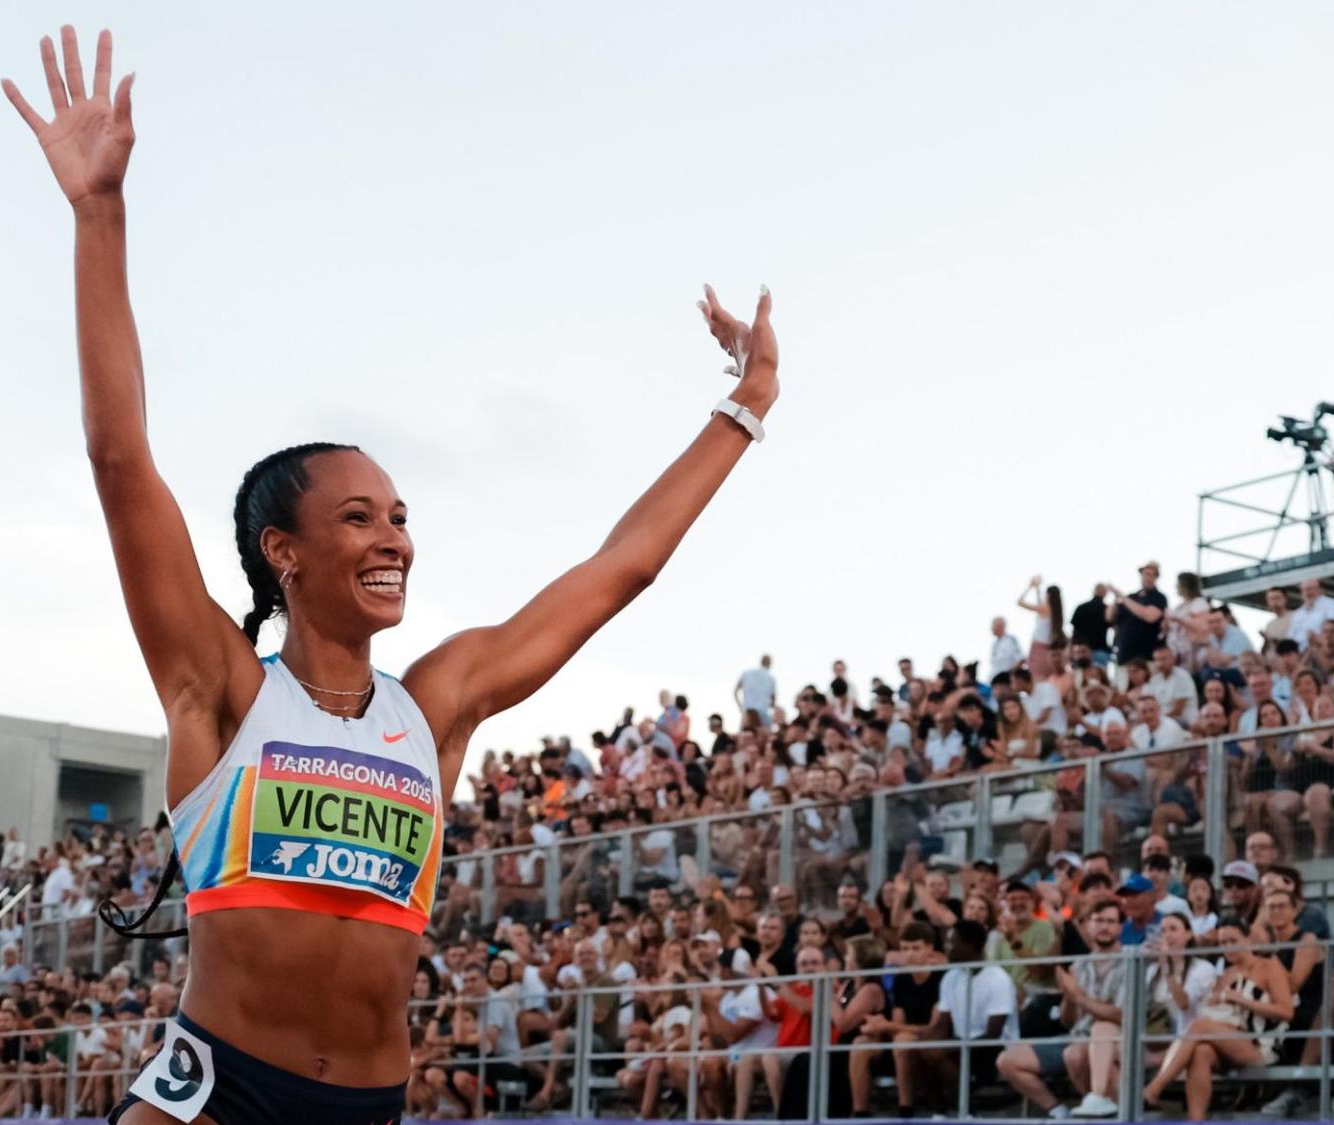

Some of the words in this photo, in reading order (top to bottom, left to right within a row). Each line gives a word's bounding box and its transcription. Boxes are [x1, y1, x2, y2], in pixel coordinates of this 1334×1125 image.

[272, 754, 397, 791] TARRAGONA
[401, 777, 432, 804] 2025
[276, 786, 423, 856] VICENTE
[155, 1037, 204, 1103] 9
